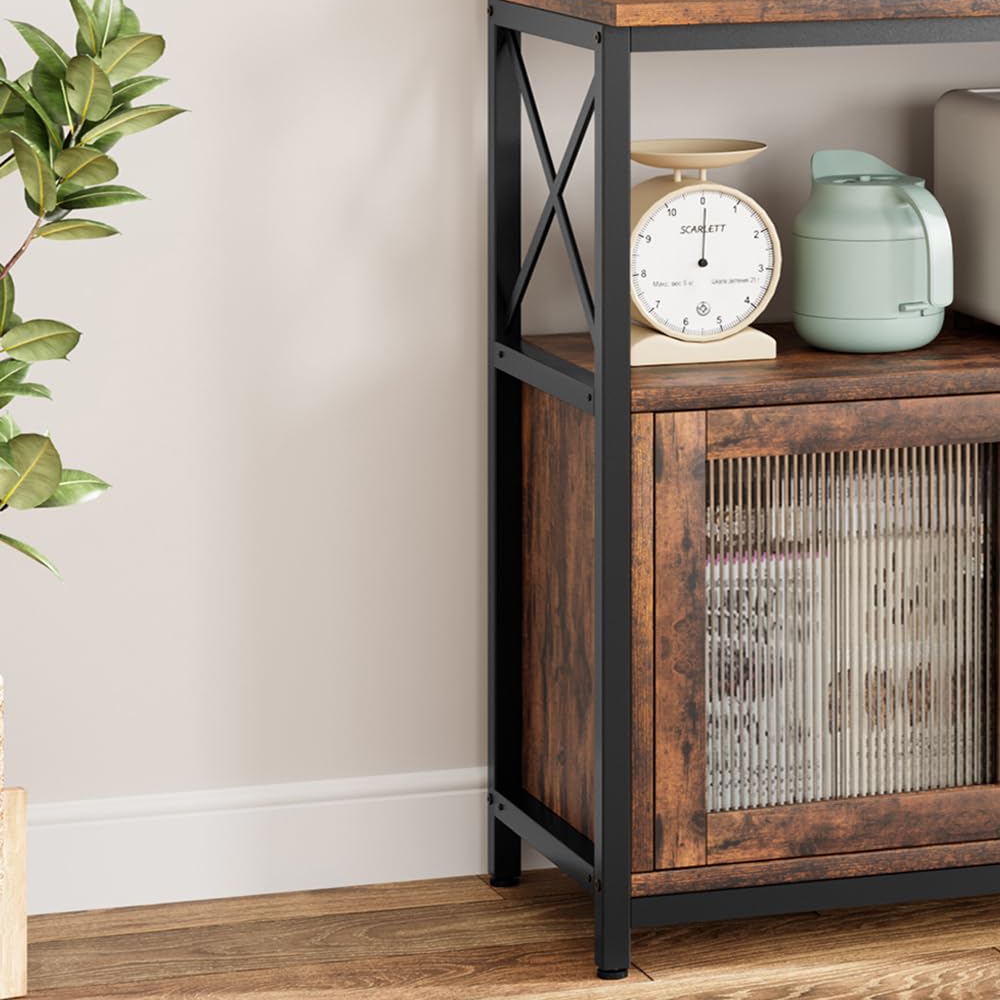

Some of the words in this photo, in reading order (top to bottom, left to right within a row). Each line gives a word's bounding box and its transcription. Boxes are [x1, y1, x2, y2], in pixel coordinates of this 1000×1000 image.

[699, 197, 706, 205] 0
[667, 208, 677, 217] 10
[732, 205, 738, 213] 1
[680, 224, 726, 235] SCARLETT
[645, 234, 652, 243] 9
[753, 230, 760, 239] 2
[758, 264, 764, 273] 3
[640, 269, 647, 278] 8
[655, 300, 661, 309] 7
[743, 296, 750, 304] 4
[682, 317, 689, 325] 6
[716, 316, 723, 324] 5
